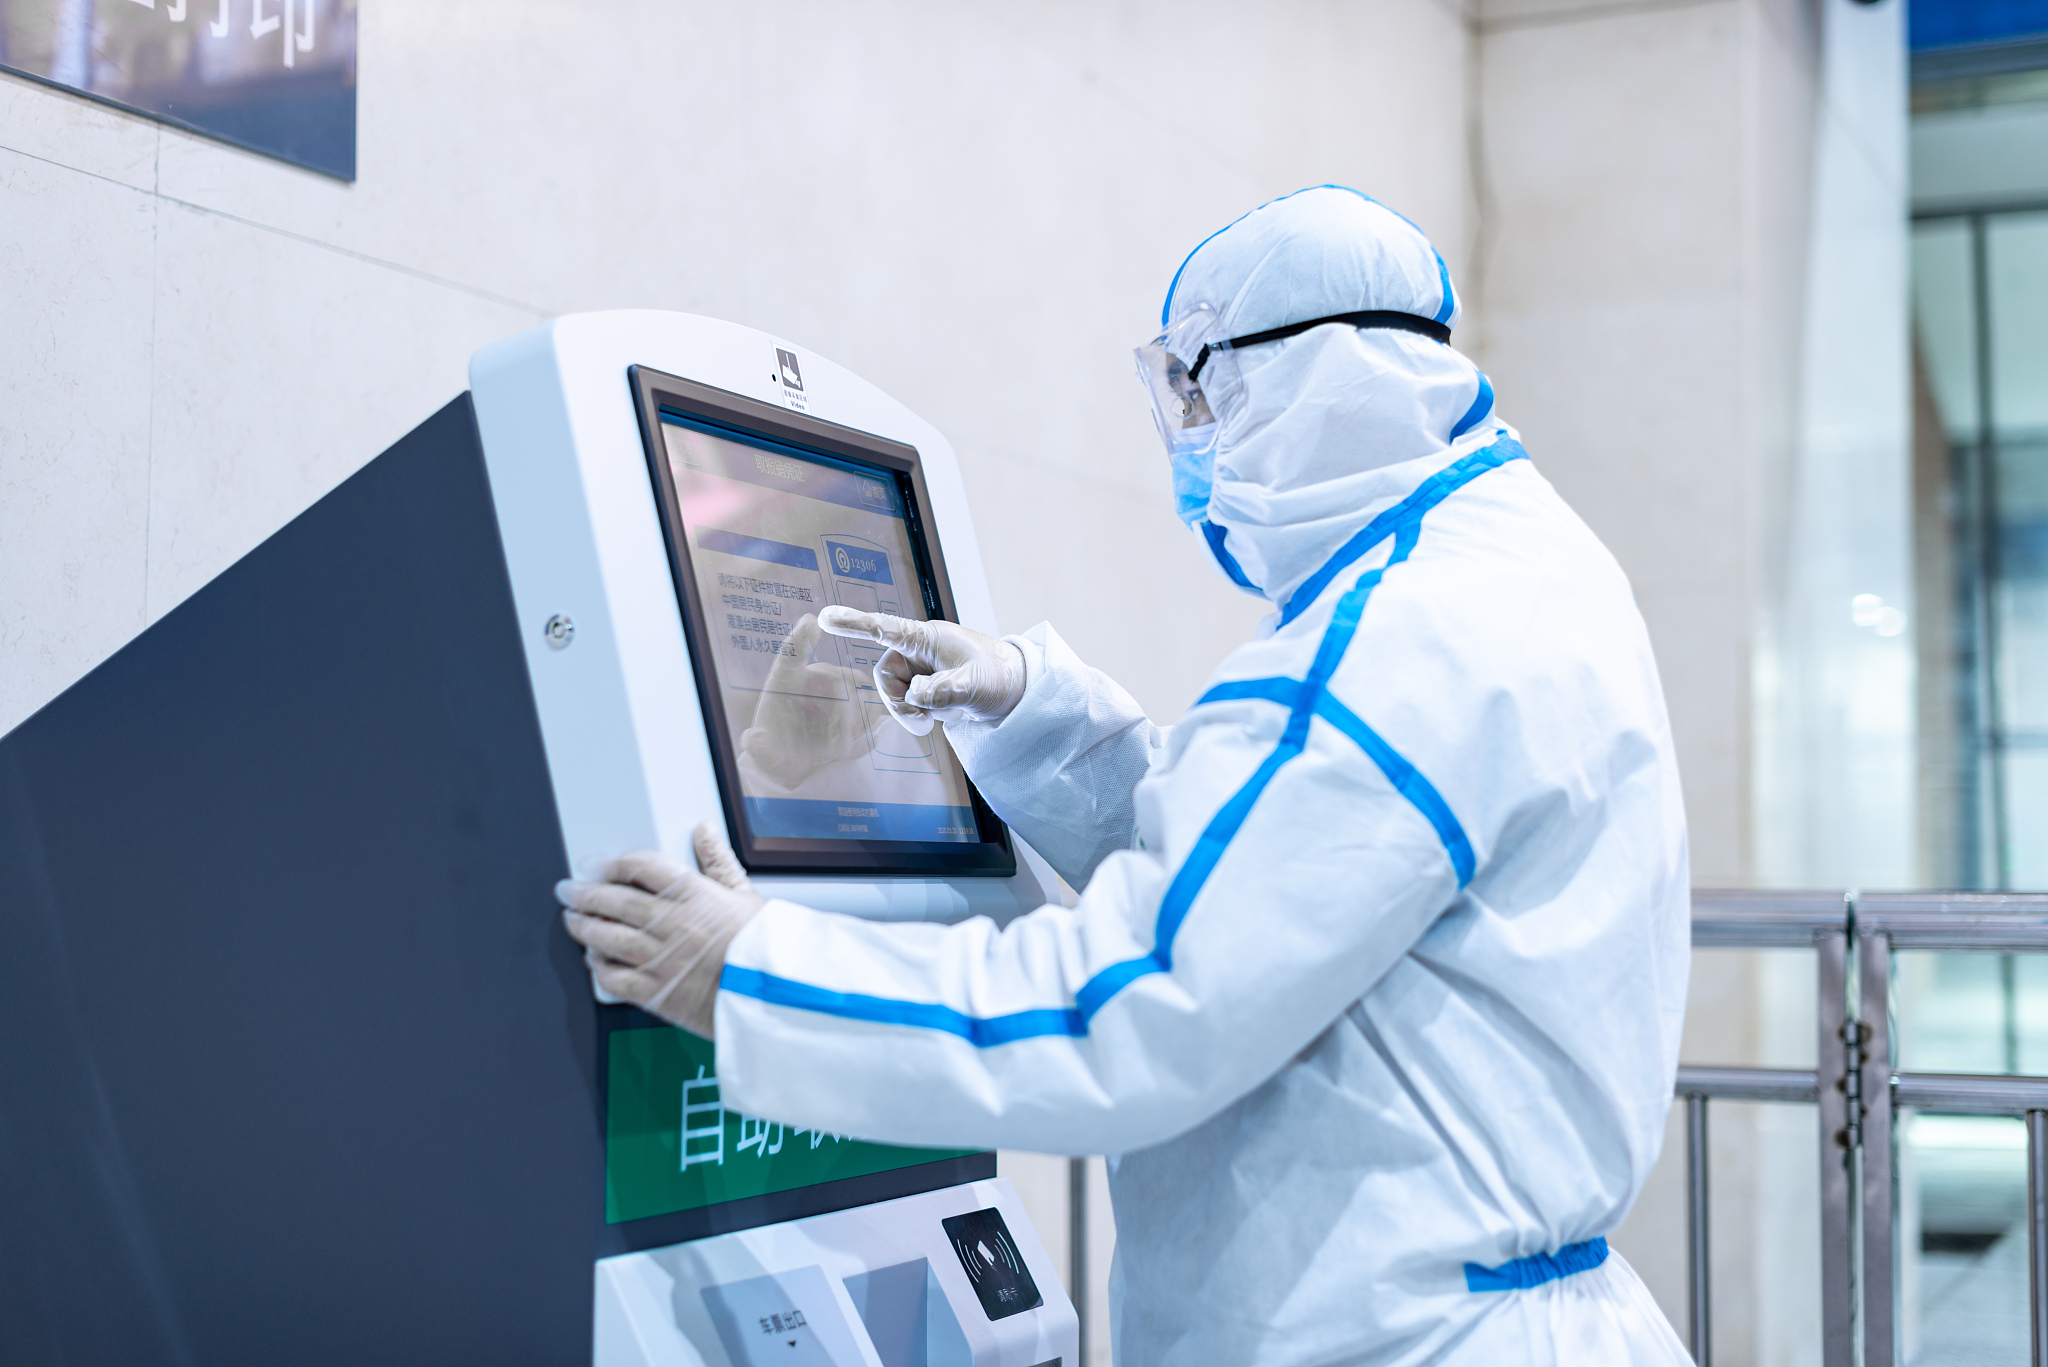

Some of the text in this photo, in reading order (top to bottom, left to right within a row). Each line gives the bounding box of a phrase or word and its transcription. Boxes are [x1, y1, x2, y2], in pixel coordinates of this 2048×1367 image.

[790, 400, 805, 410] Video
[754, 454, 805, 482] 取报销凭证
[872, 486, 887, 500] 首页
[851, 557, 876, 572] 12306
[759, 1309, 807, 1335] 车票出口
